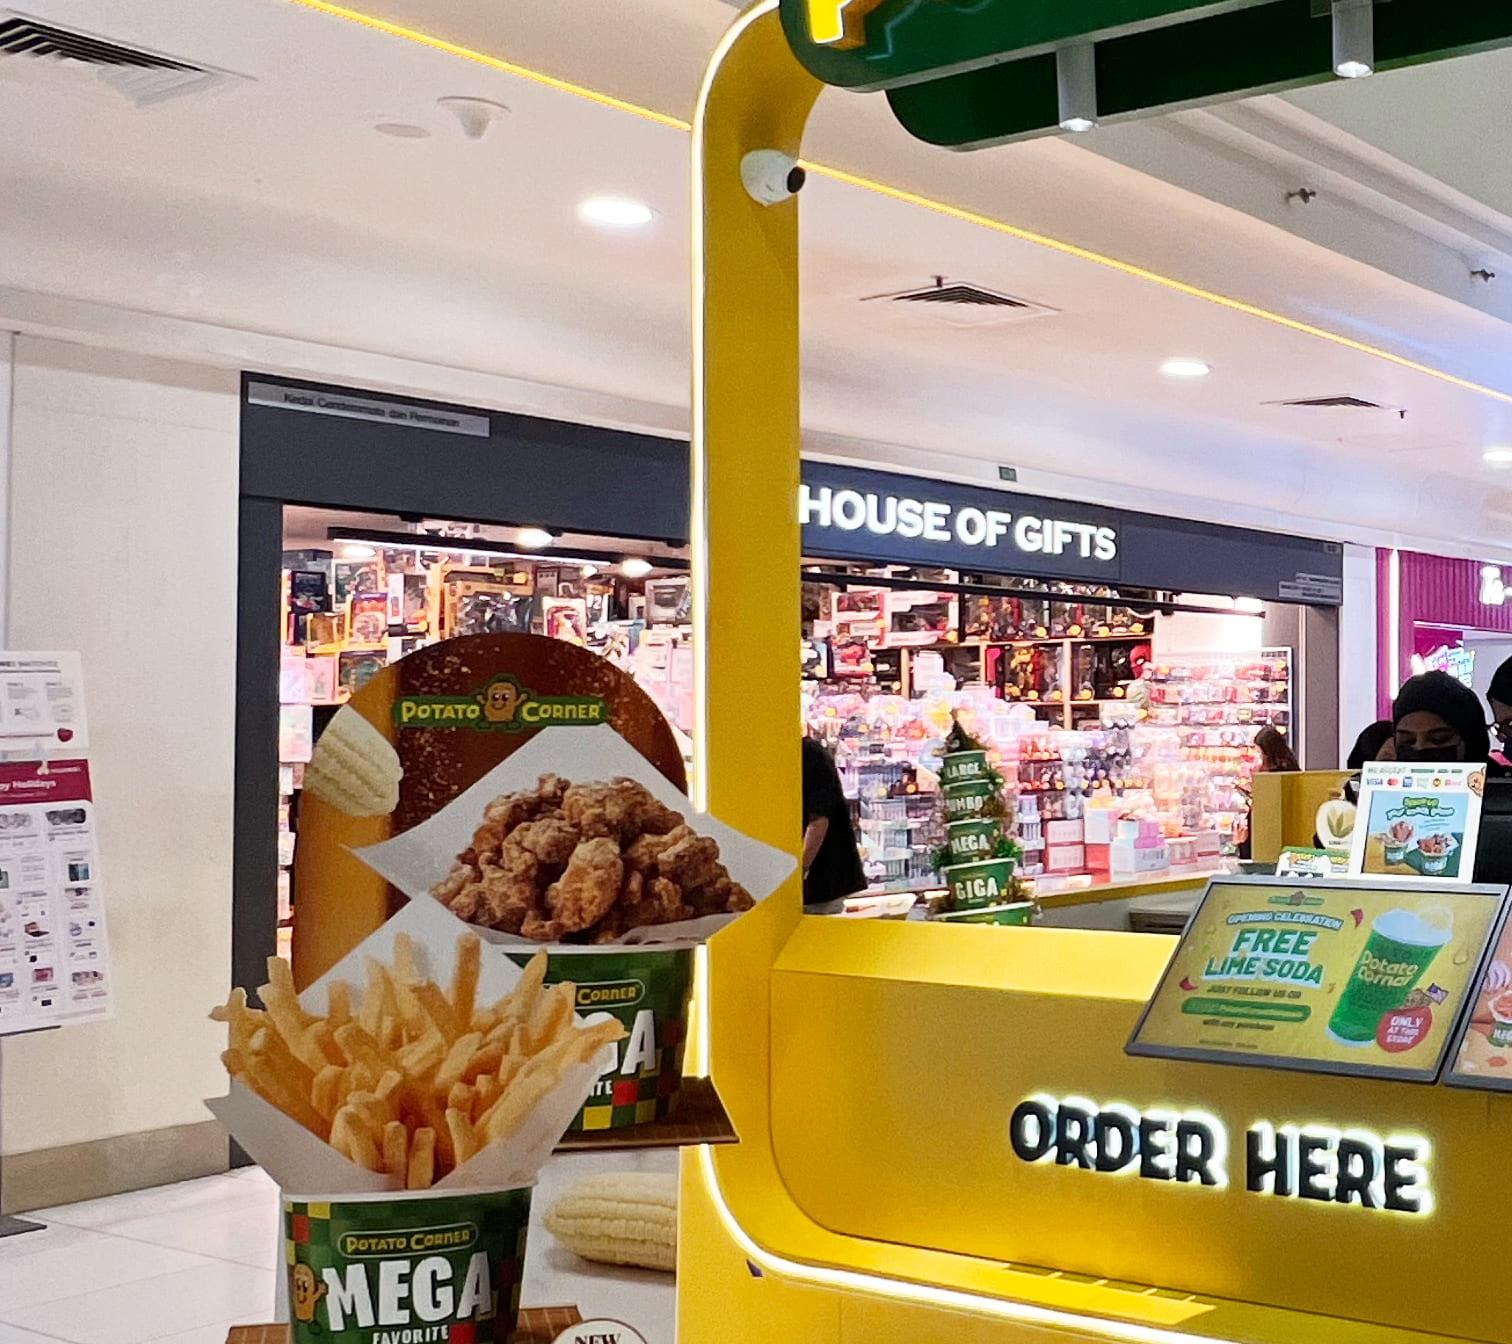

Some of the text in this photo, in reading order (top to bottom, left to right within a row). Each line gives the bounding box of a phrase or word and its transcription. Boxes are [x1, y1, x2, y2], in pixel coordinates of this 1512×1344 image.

[799, 484, 1117, 561] HOUSE OF GIFTS
[400, 700, 602, 723] POTATO CORNER
[955, 877, 998, 899] GIGA
[1232, 928, 1319, 956] FREE
[1204, 957, 1324, 984] LIME SODA
[577, 987, 637, 1004] CORNER
[1010, 1098, 1430, 1213] ORDER HERE
[346, 1228, 472, 1254] POTATO CORNER
[322, 1251, 492, 1331] MEGA
